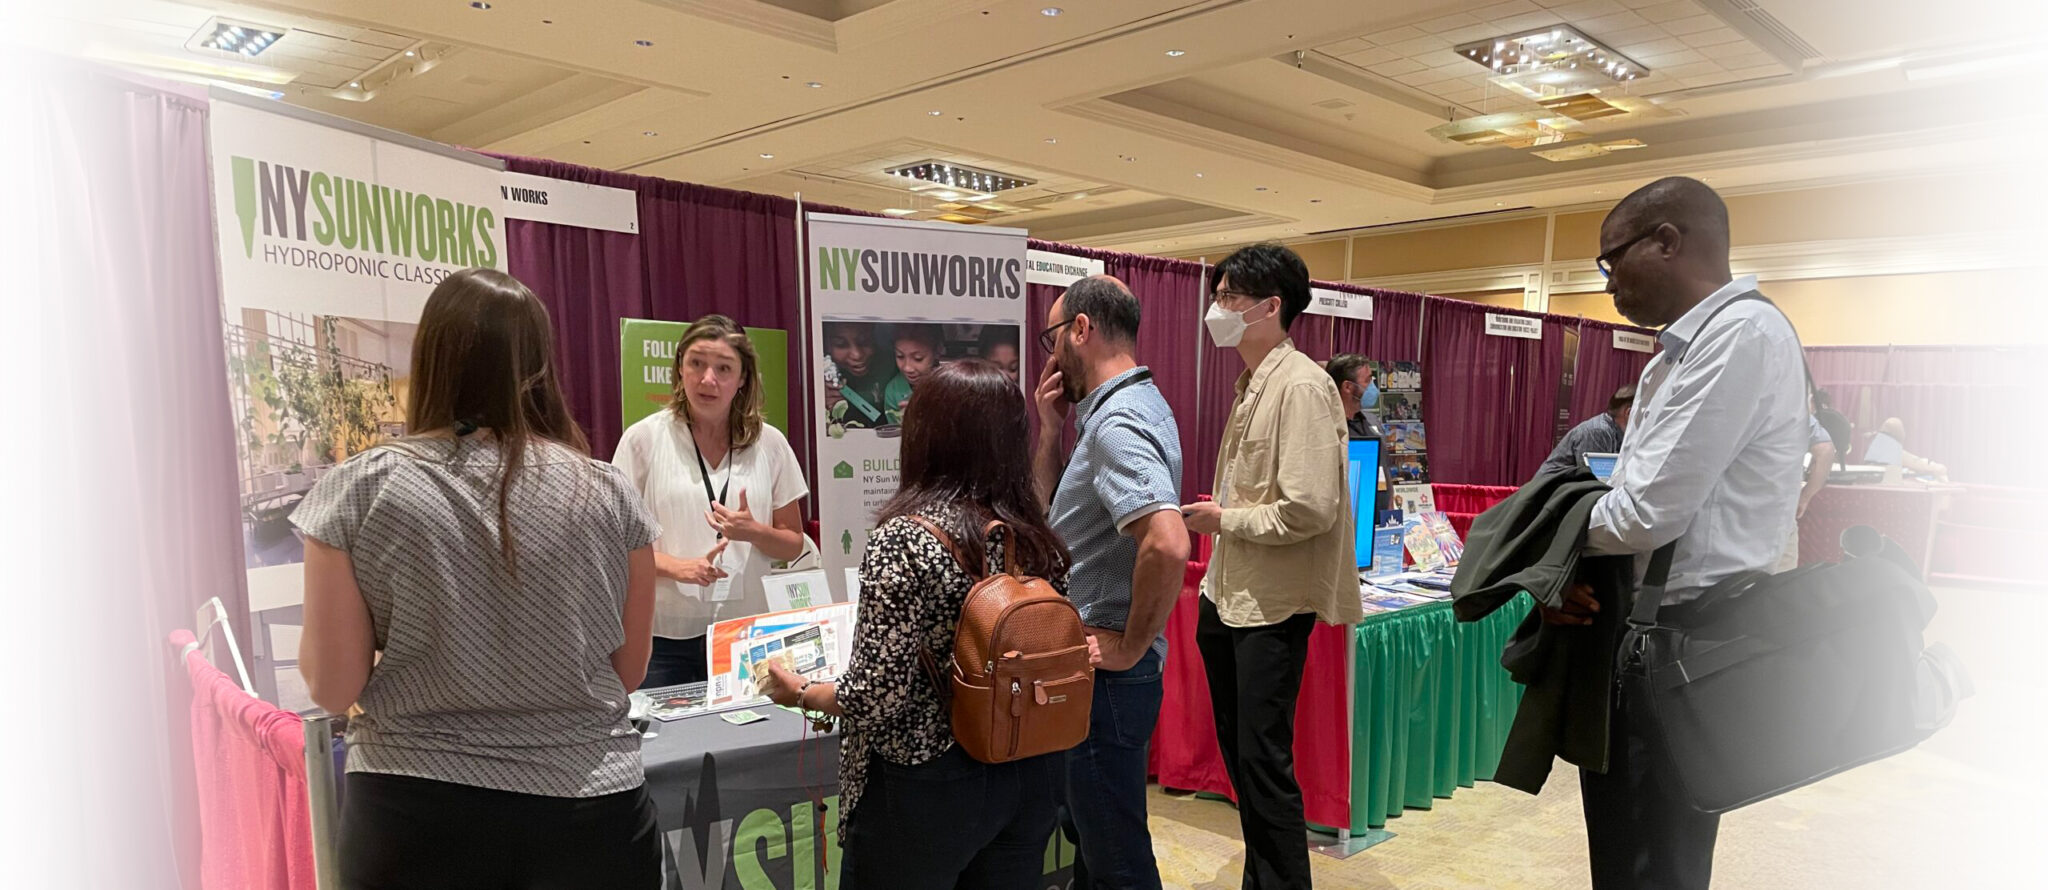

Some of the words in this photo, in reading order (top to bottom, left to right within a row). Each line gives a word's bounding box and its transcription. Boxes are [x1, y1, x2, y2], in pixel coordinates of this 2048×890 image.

[511, 187, 548, 205] WORKS
[258, 161, 497, 268] NYSUNWORKS
[264, 244, 388, 278] HYDROPONIC
[1036, 261, 1064, 275] EDUCATION
[1065, 265, 1088, 277] EXCHANGE
[819, 246, 1020, 299] NYSUNWORKS
[643, 340, 679, 359] FOLL
[643, 365, 672, 384] LIKE
[863, 475, 874, 483] NY
[875, 475, 890, 483] Sun
